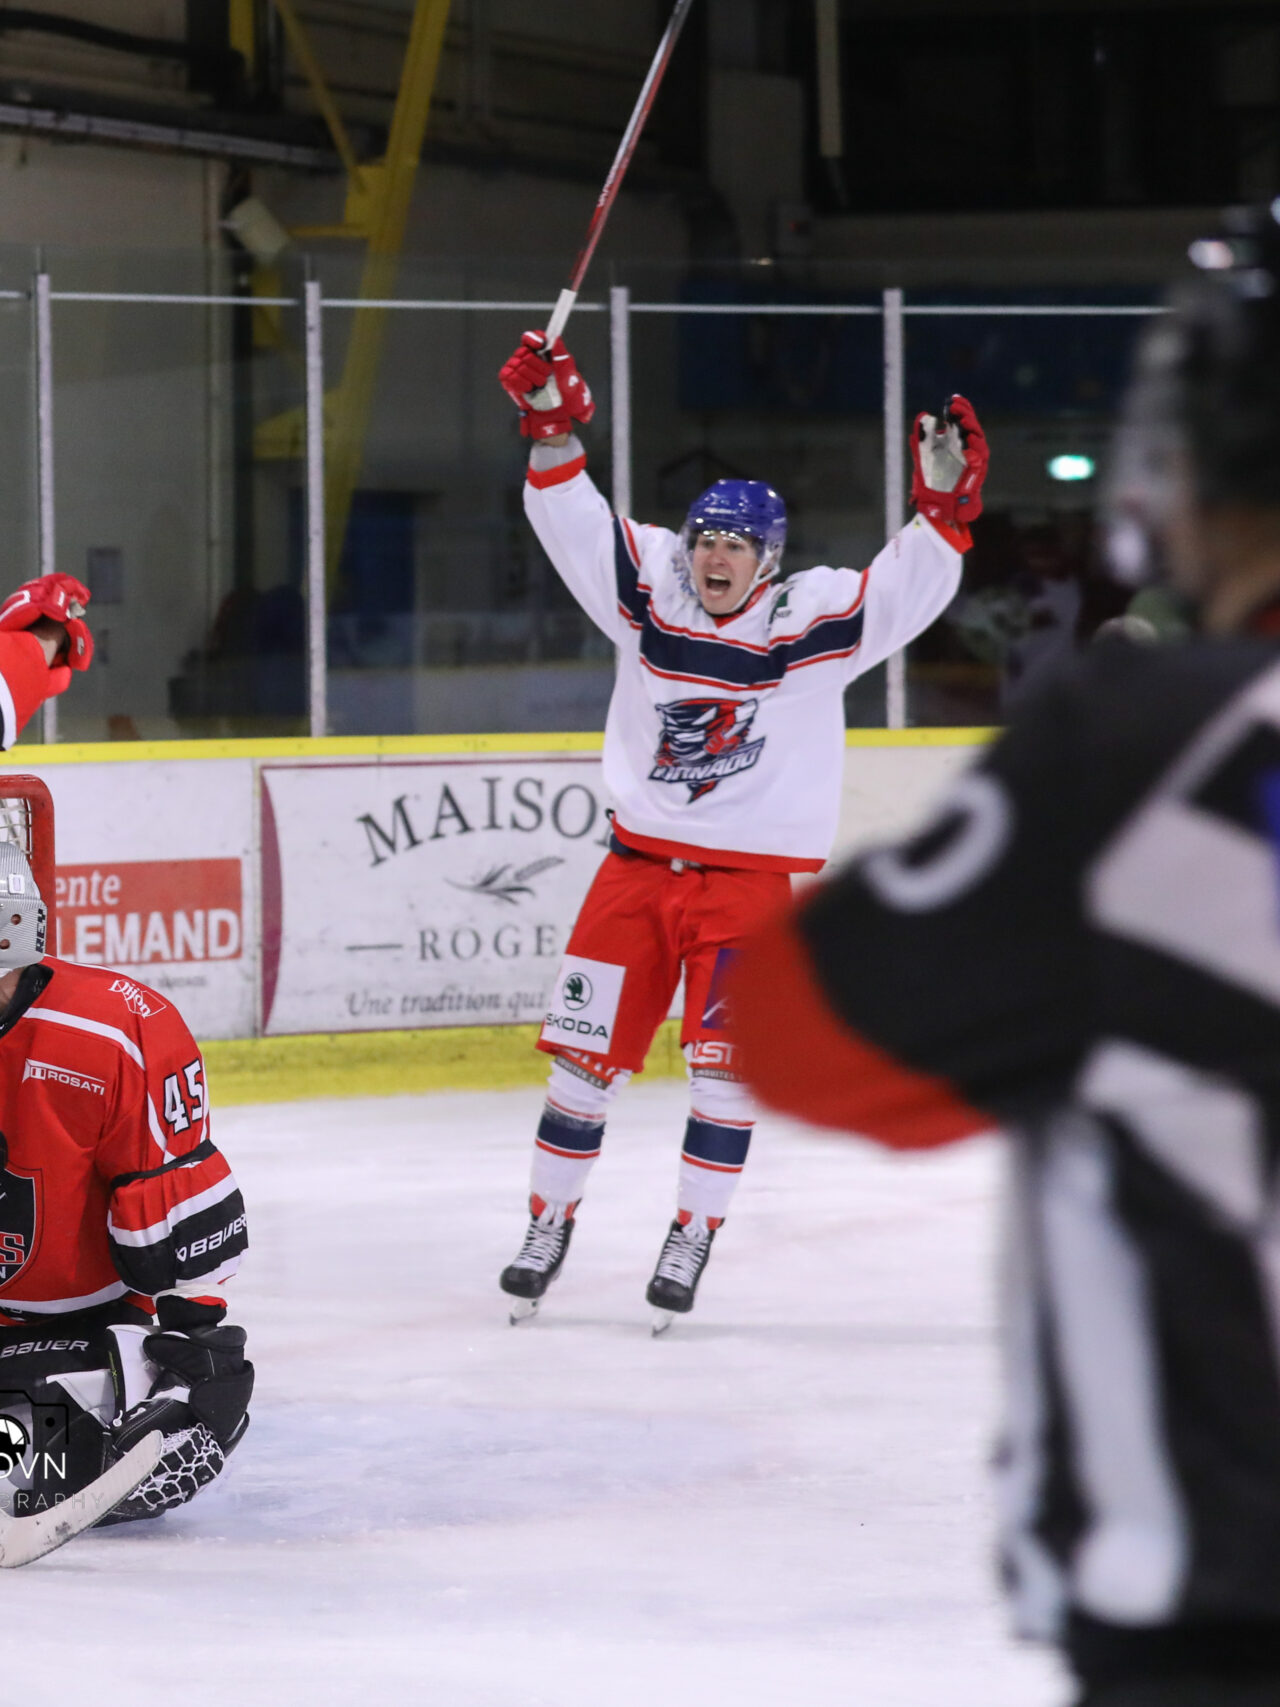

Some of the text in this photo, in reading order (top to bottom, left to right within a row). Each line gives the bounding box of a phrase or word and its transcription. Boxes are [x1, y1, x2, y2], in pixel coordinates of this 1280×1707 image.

[355, 777, 612, 868] MAISO
[36, 909, 46, 953] REY
[419, 924, 573, 961] ROGE
[108, 979, 151, 1018] Dijon
[401, 983, 499, 1014] tradition
[48, 1071, 104, 1095] ROSATI
[164, 1058, 204, 1134] 45
